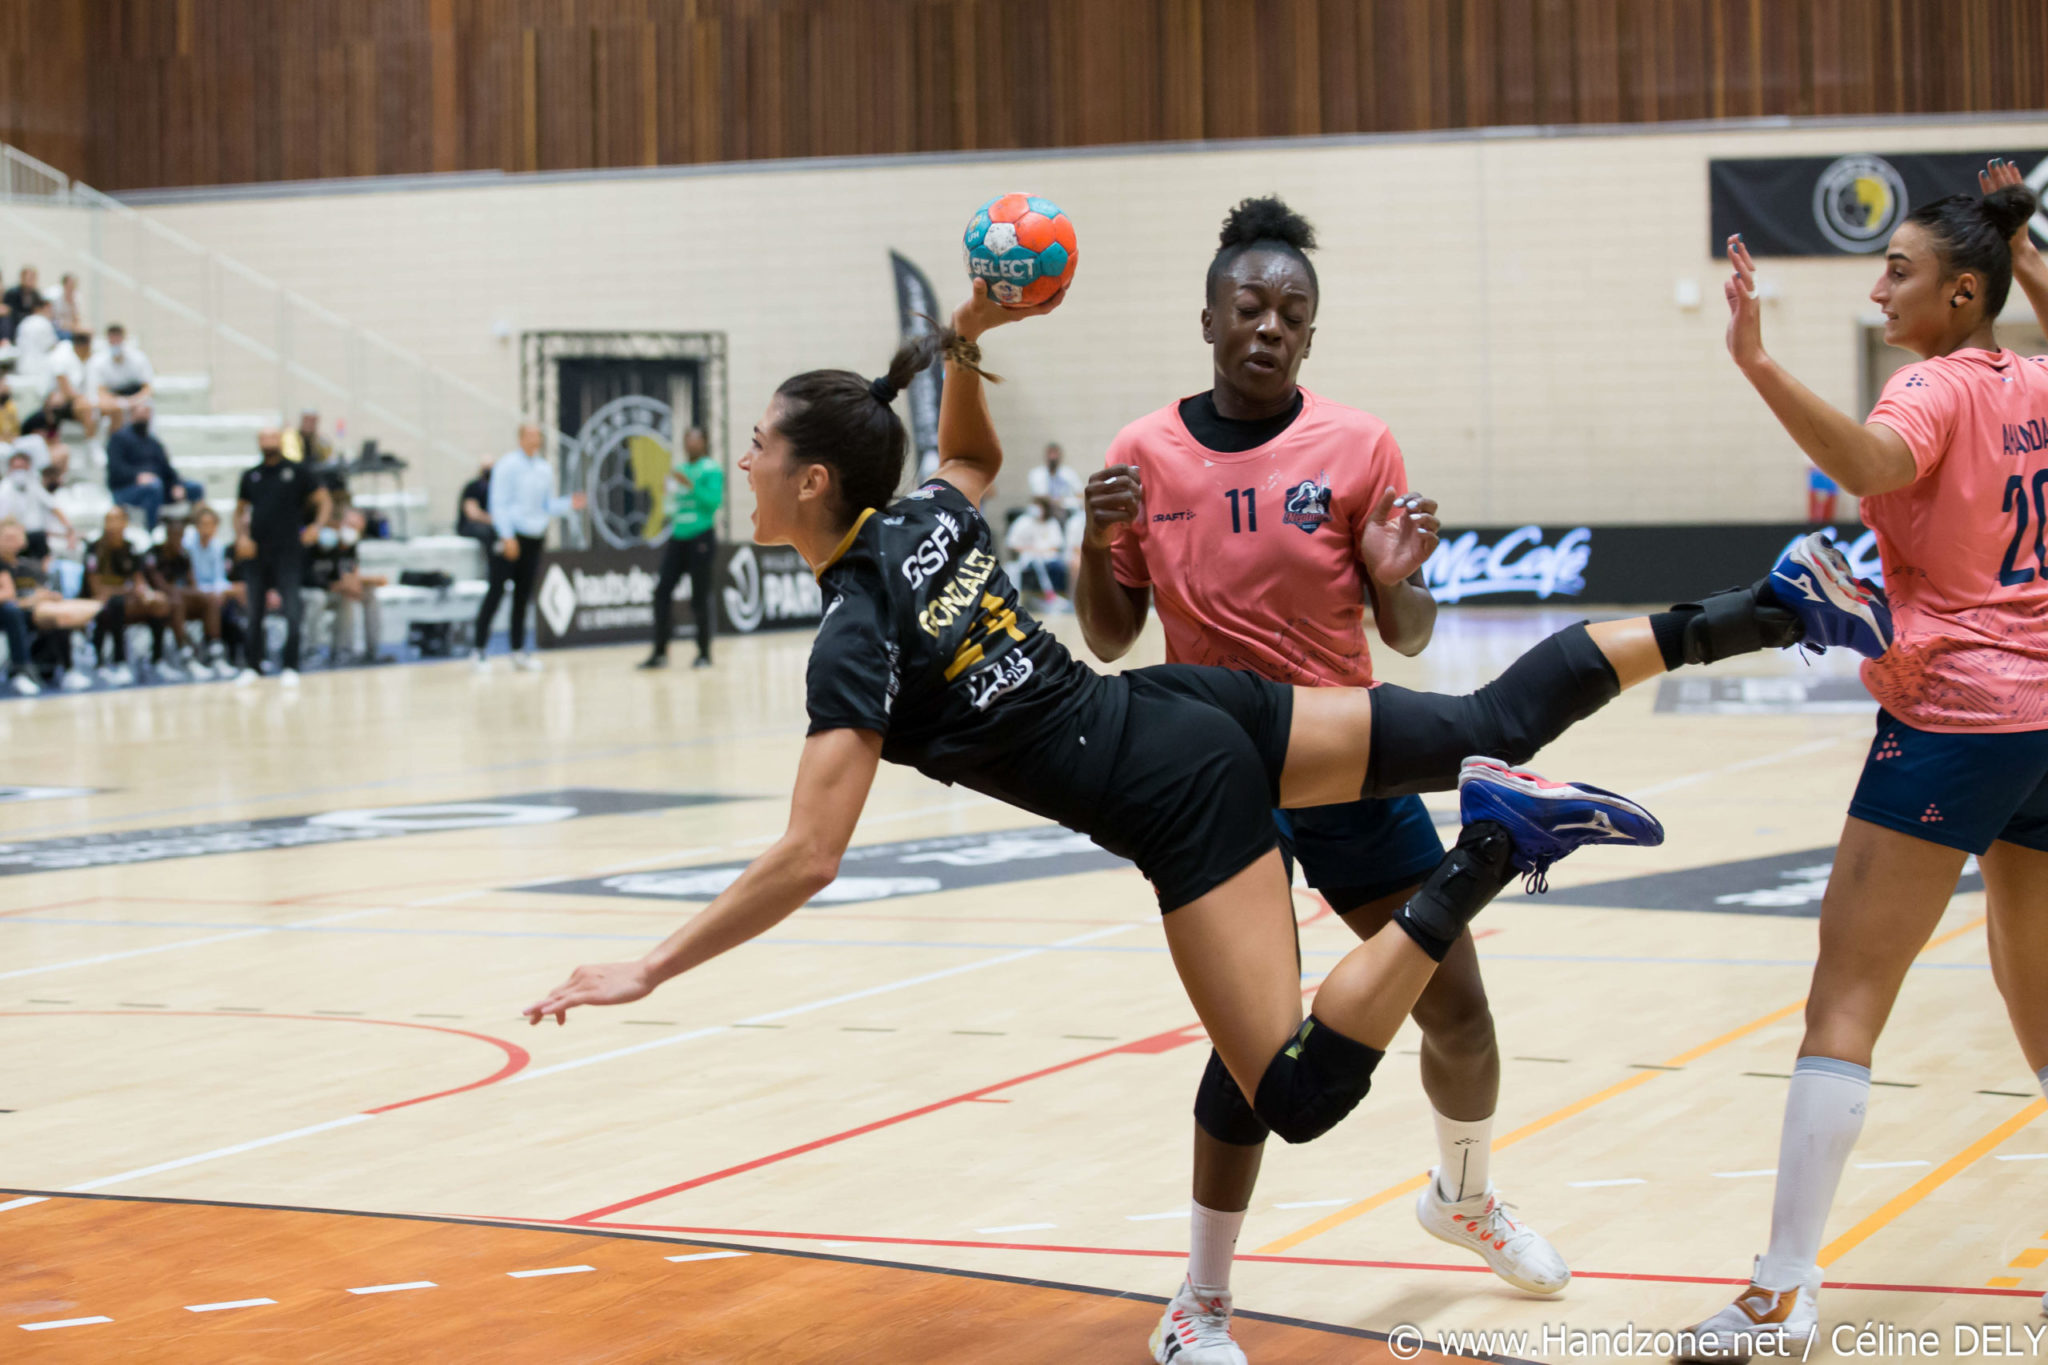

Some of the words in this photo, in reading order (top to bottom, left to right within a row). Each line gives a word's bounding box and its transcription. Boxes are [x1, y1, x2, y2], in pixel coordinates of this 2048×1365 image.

[971, 257, 1035, 279] SELECT
[1153, 511, 1186, 523] CRAFT
[1225, 488, 1257, 533] 11
[902, 524, 950, 590] GSF
[919, 547, 996, 638] GONZALE
